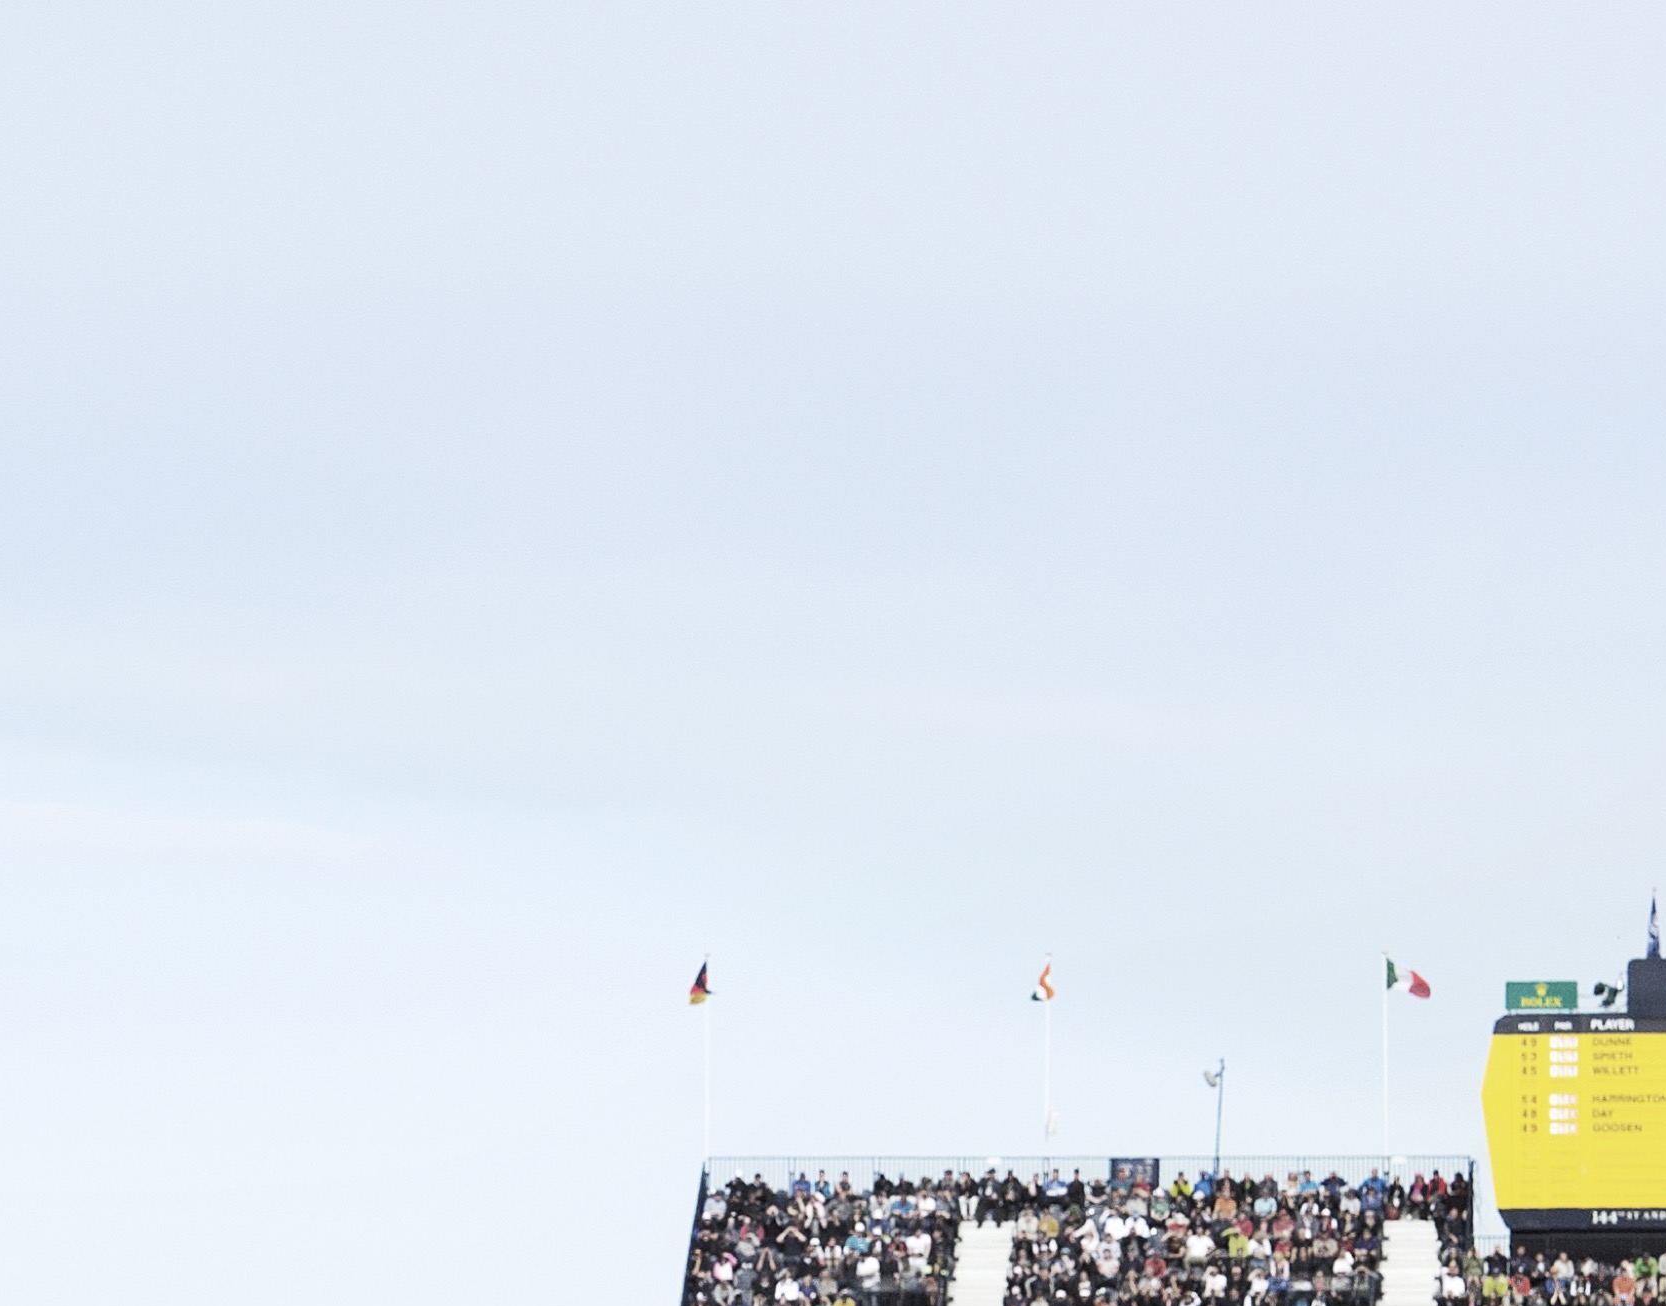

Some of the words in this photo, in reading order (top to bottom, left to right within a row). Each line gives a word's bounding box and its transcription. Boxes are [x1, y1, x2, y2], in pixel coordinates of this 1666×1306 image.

[1589, 1018, 1635, 1031] PLAYER
[1592, 1052, 1633, 1061] SPIETH
[1593, 1066, 1640, 1075] WILLETT
[1592, 1109, 1614, 1118] DAY
[1592, 1123, 1643, 1132] GOOSEN
